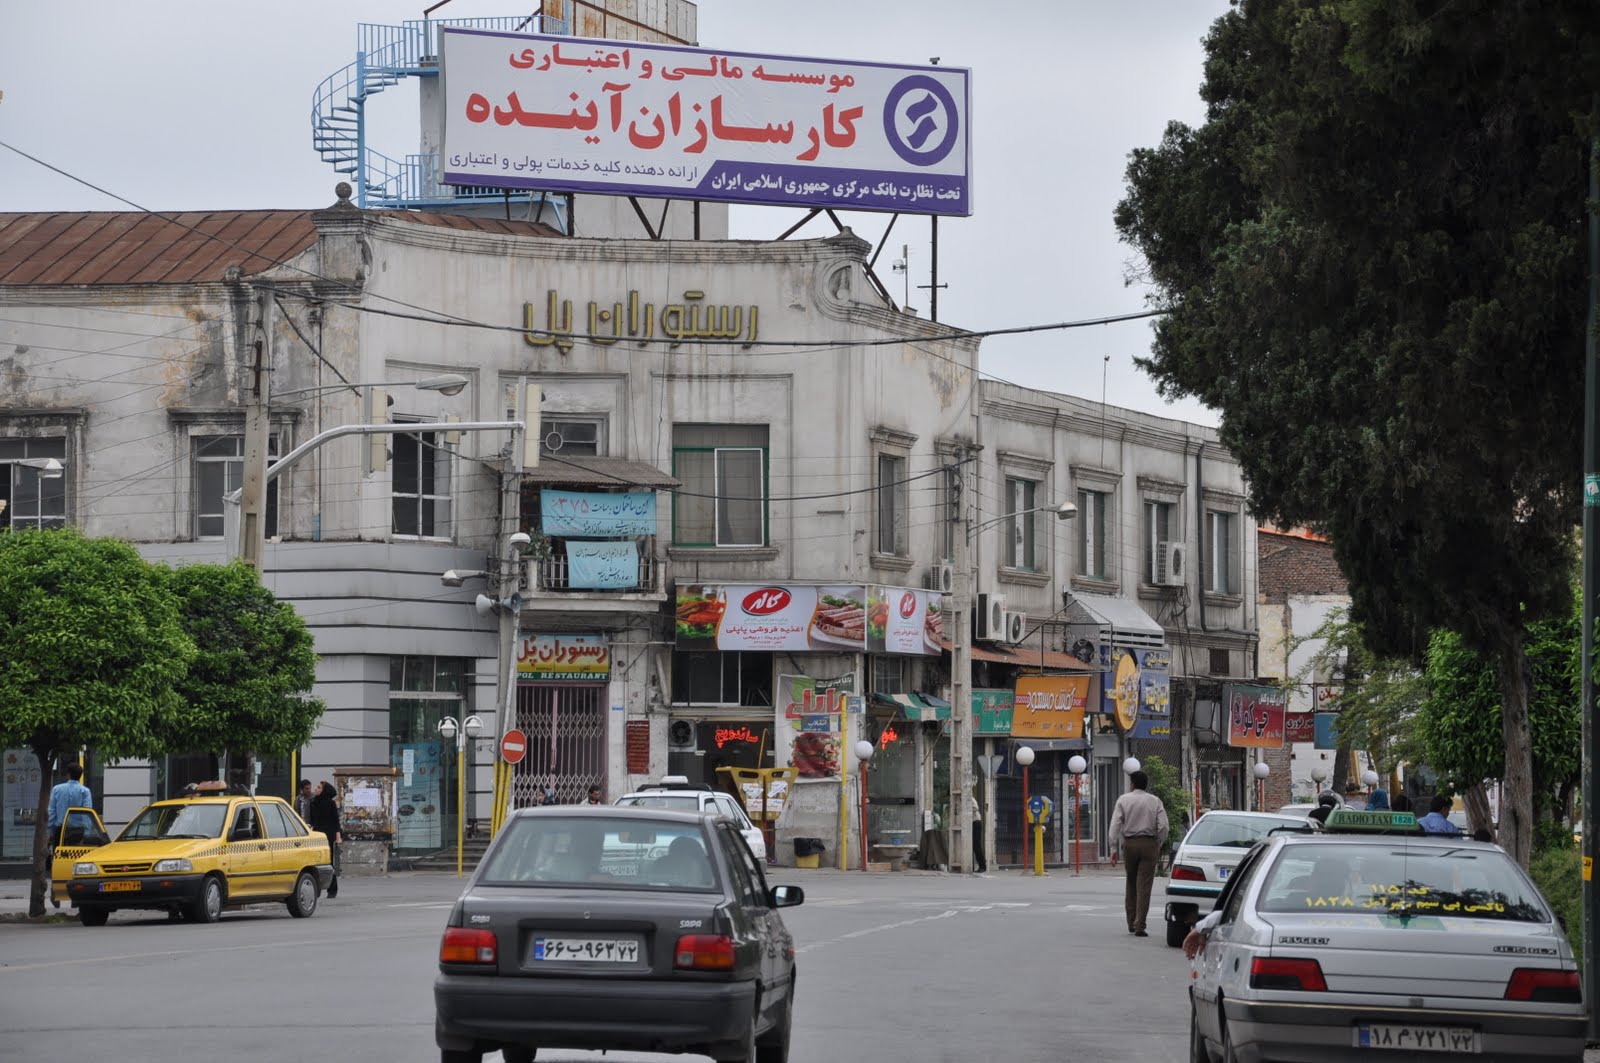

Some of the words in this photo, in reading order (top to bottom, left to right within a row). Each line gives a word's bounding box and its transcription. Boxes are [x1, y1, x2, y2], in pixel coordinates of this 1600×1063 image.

[509, 43, 631, 72] اعتباری
[638, 61, 650, 79] و
[661, 55, 743, 81] مالی
[752, 61, 855, 93] موسسه
[465, 81, 631, 144] آینده
[449, 154, 497, 167] اعتباری
[502, 159, 509, 171] و
[513, 155, 543, 174] پولی
[547, 159, 590, 171] خدمات
[593, 160, 621, 174] کلیه
[625, 164, 664, 176] دهنده
[711, 172, 741, 190] ایران
[743, 174, 782, 191] اسلامی
[785, 181, 830, 195] جمهوری
[832, 180, 869, 197] مرکزی
[872, 181, 897, 200] بانک
[899, 183, 934, 201] نظارت
[936, 187, 960, 200] تحت
[588, 290, 758, 350] رستوران
[749, 625, 778, 634] فروشی
[539, 638, 608, 664] رستوران
[540, 672, 608, 680] RESTAURANT
[1338, 814, 1369, 825] RADIO
[1371, 814, 1392, 825] TAXI
[1393, 816, 1413, 824] 1828
[1416, 900, 1440, 909] سیم
[1443, 901, 1461, 911] بی
[1464, 902, 1505, 912] تاکسی
[679, 919, 702, 929] SAIPA
[1279, 935, 1330, 945] PEUGEOT
